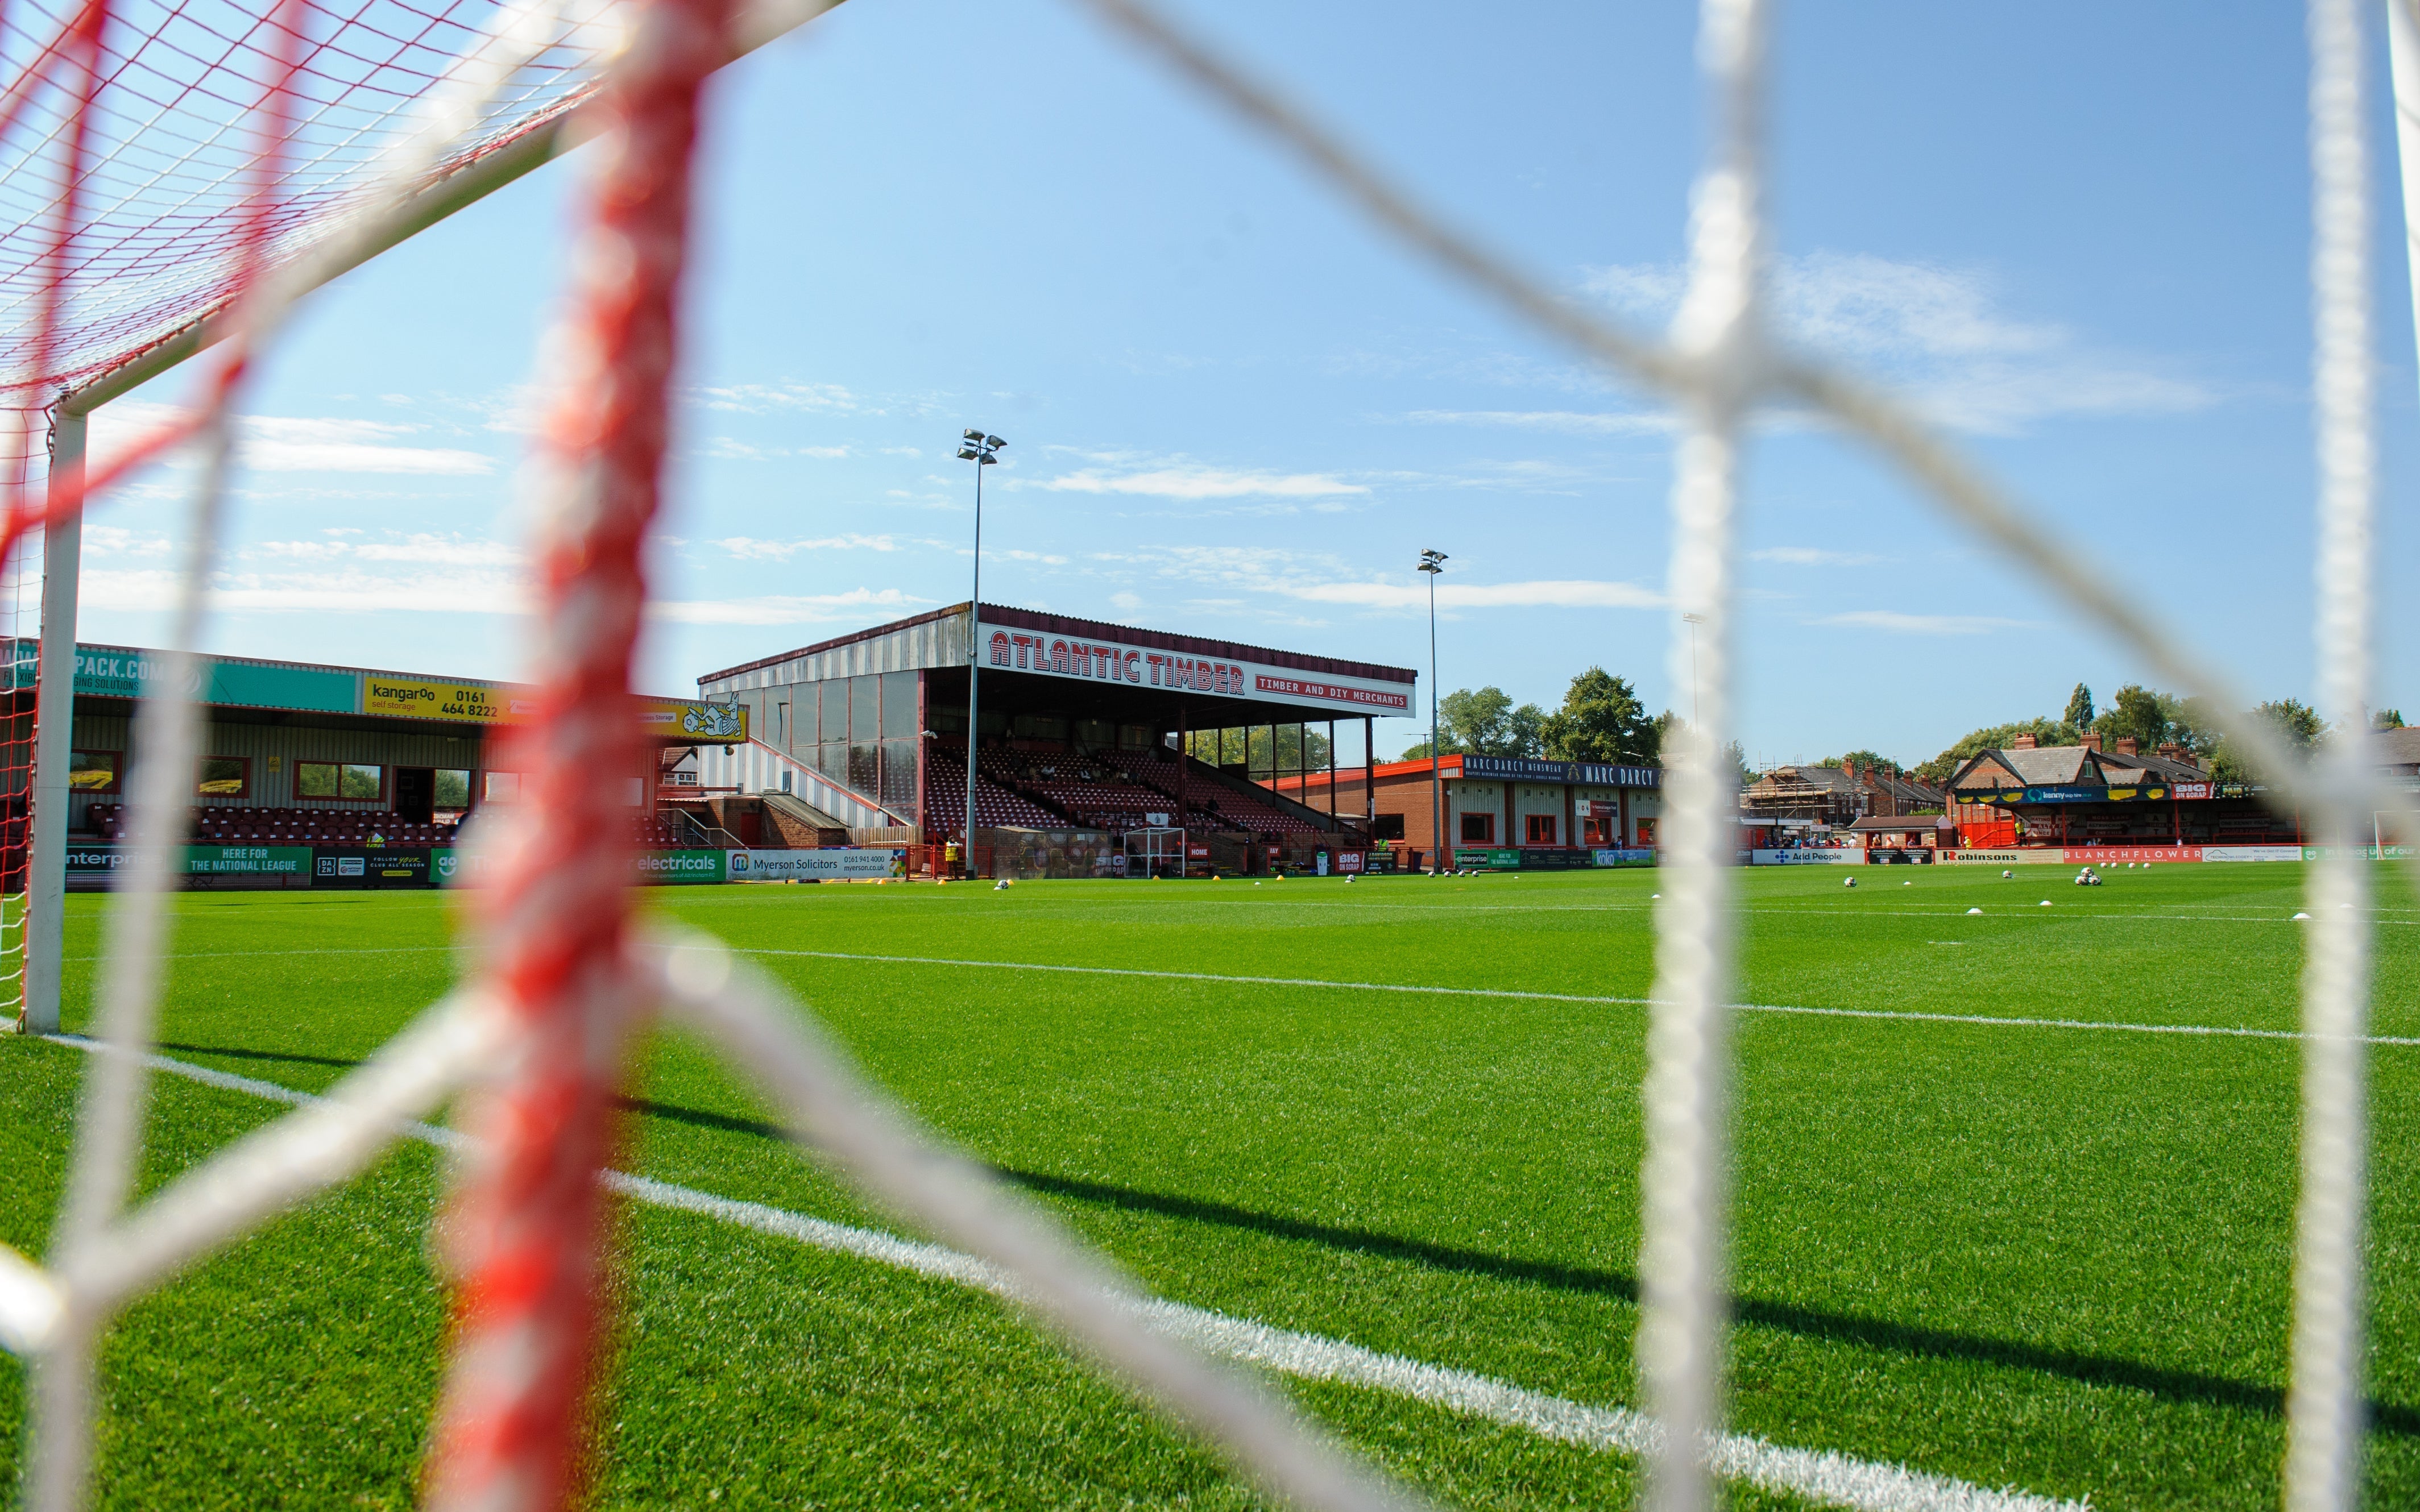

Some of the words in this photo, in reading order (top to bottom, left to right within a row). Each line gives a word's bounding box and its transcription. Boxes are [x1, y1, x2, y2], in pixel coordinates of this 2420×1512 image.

[989, 631, 1139, 682] ATLANTIC
[1146, 653, 1245, 695] TIMBER
[94, 679, 139, 691] SOLUTIONS
[372, 684, 435, 702] kangaroo
[456, 690, 486, 703] 0161
[1259, 678, 1299, 692] TIMBER
[1305, 684, 1324, 695] AND
[1330, 688, 1348, 698] DIY
[1353, 691, 1404, 705] MERCHANTS
[388, 701, 416, 711] storage
[441, 703, 465, 715] 464
[468, 704, 498, 717] 8222
[1466, 757, 1490, 770] MARC
[1495, 759, 1523, 771] DARCY
[1528, 763, 1561, 772] MENSWEAR
[1586, 766, 1614, 783] MARC
[1620, 768, 1652, 785] DARCY
[2175, 784, 2207, 792] BIG
[222, 849, 247, 858] HERE
[250, 849, 268, 858] FOR
[1339, 854, 1360, 863] BIG
[1457, 855, 1487, 863] enterprise
[1812, 853, 1842, 861] People
[1943, 851, 2017, 861] Robinsons
[191, 861, 210, 870] THE
[213, 861, 259, 870] NATIONAL
[262, 861, 296, 870] LEAGUE
[637, 855, 715, 870] electricals
[754, 859, 794, 871] Myerson
[796, 859, 838, 870] Solicitors
